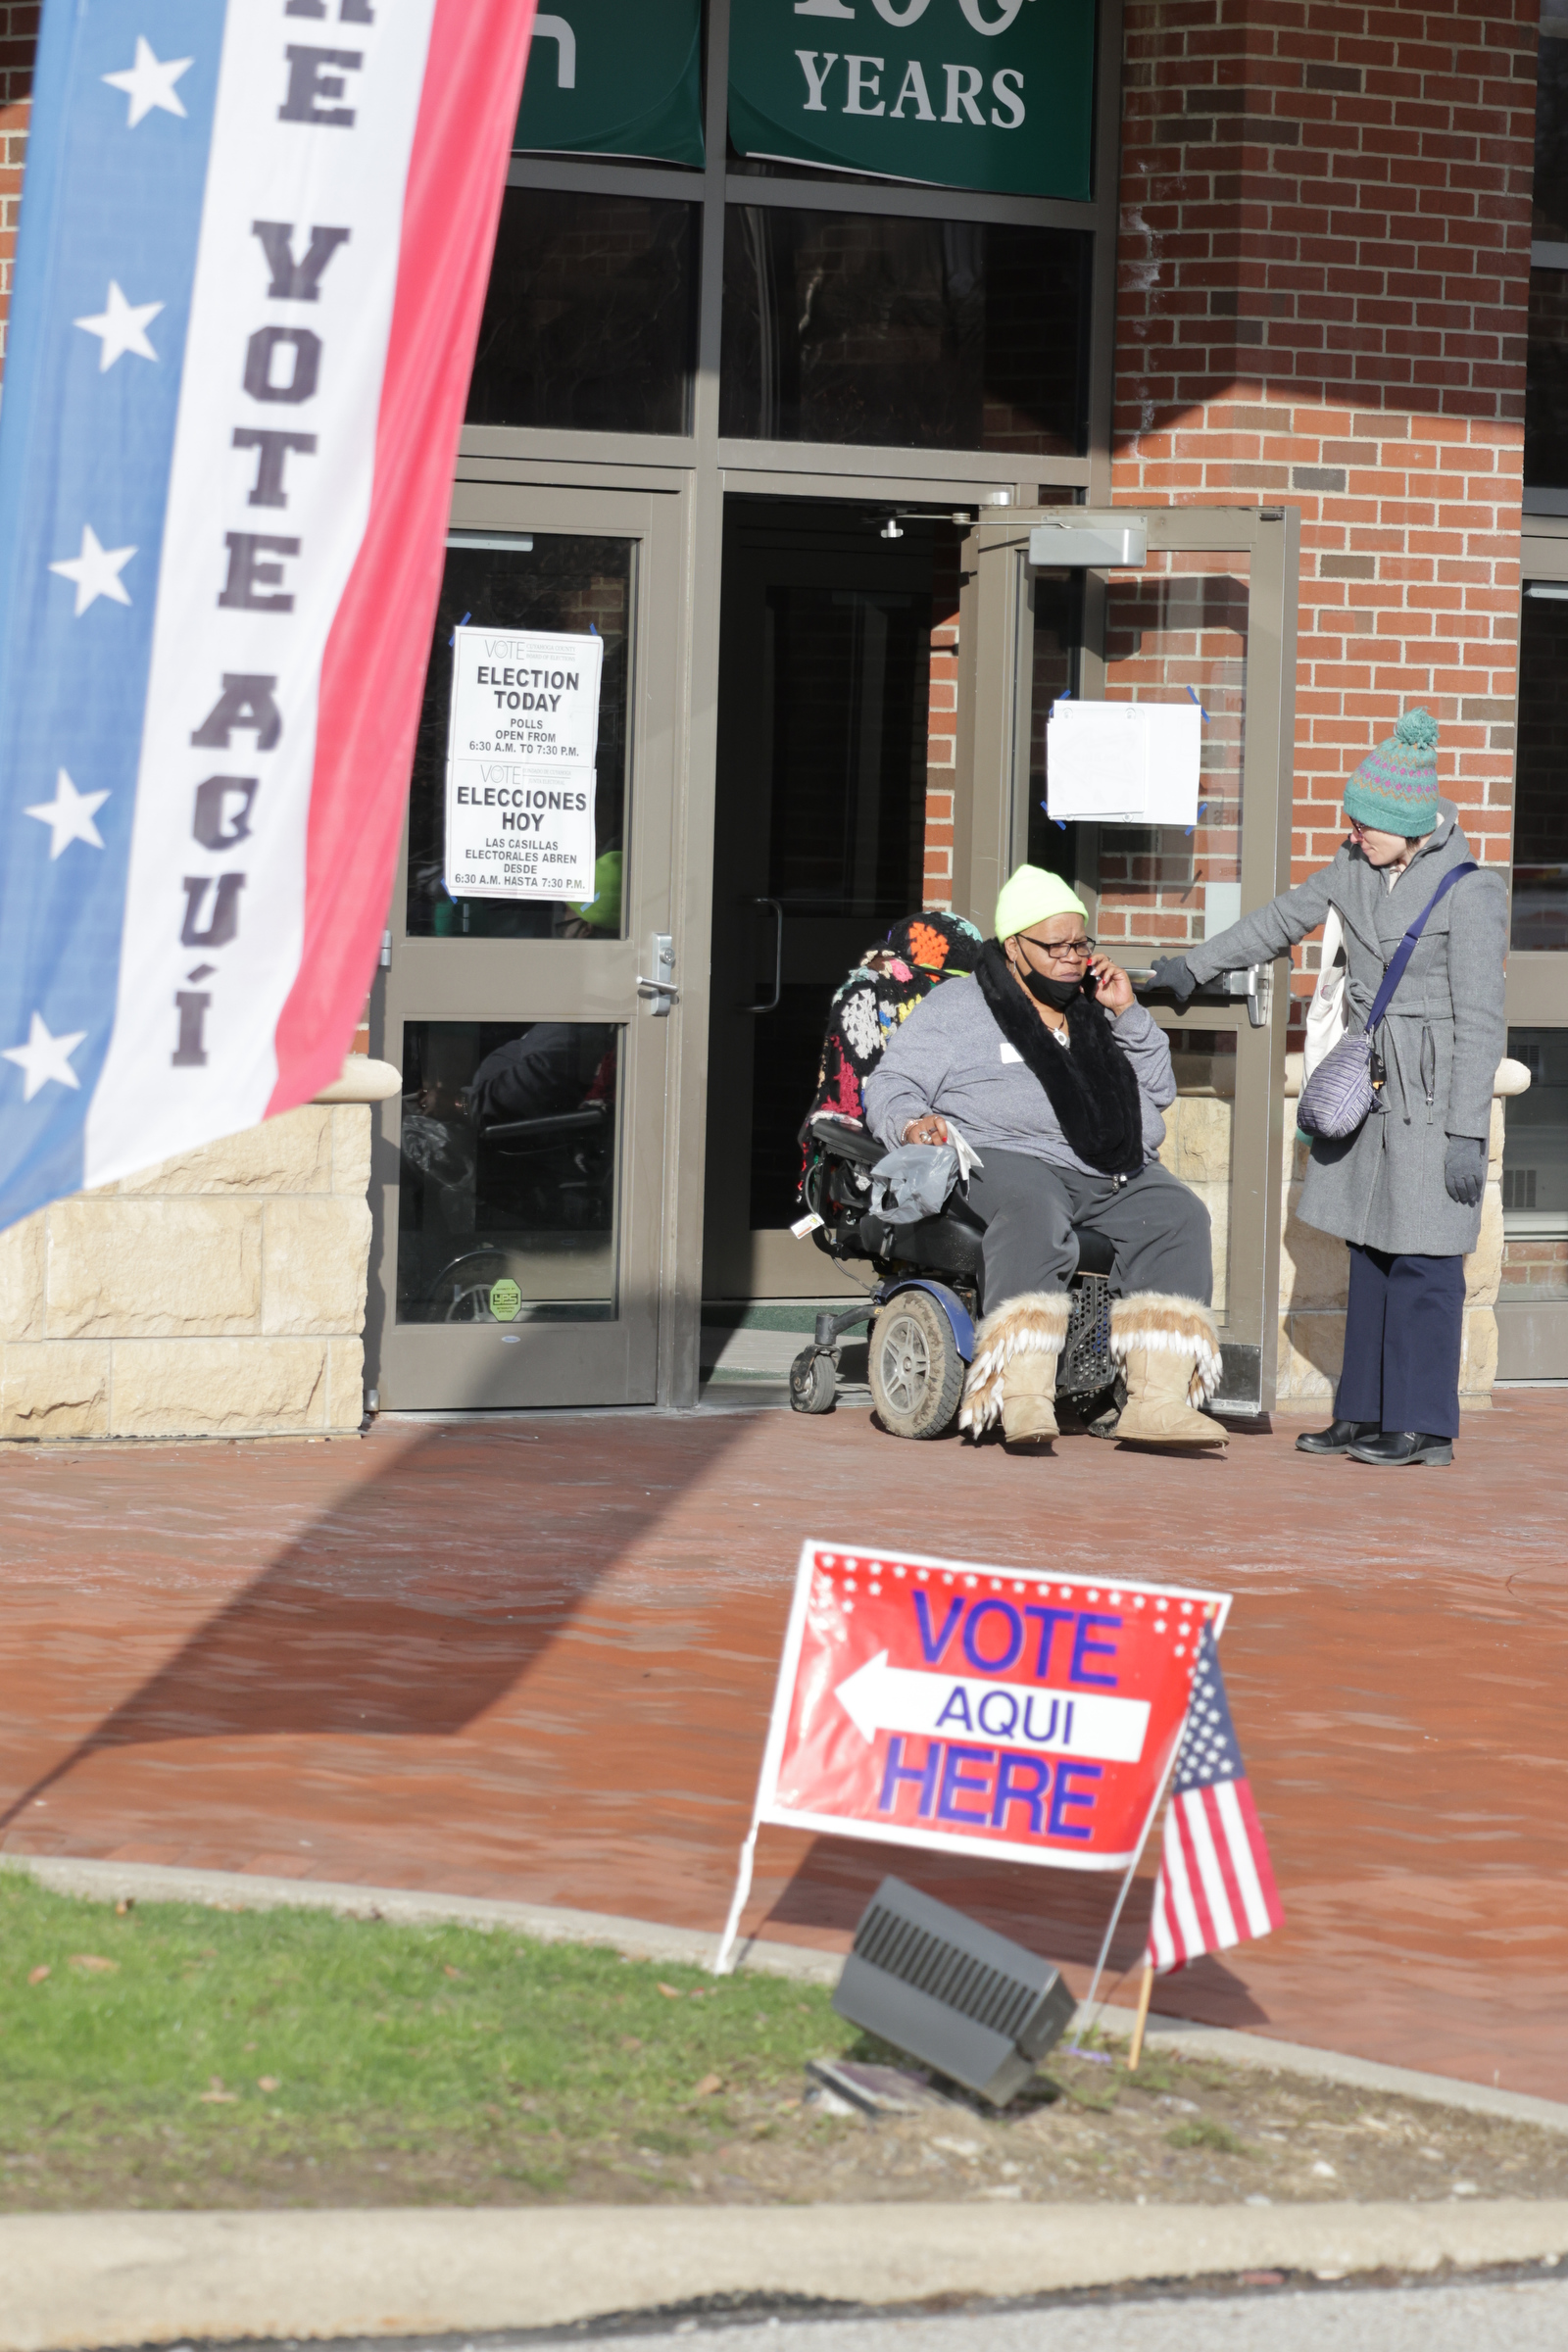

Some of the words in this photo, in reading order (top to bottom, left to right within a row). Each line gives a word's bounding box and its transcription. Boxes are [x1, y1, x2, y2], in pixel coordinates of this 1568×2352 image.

[794, 49, 1026, 129] YEARS
[217, 219, 352, 612] VOTE
[485, 639, 525, 660] VOTE
[477, 665, 579, 691] ELECTION
[494, 690, 562, 712] TODAY
[510, 718, 543, 729] POLLS
[495, 730, 524, 741] OPEN
[527, 731, 556, 743] FROM
[469, 741, 491, 752] 6:30
[494, 742, 516, 753] A.M.
[520, 744, 533, 754] TO
[537, 745, 558, 755] 7:30
[561, 747, 579, 757] P.M.
[480, 764, 521, 784] VOTE
[457, 786, 587, 811] ELECCIONES
[502, 811, 545, 832] HOY
[485, 838, 506, 848] LAS
[509, 839, 559, 851] CASILLAS
[466, 849, 539, 862] ELECTORALES
[542, 853, 577, 864] ABREN
[504, 863, 538, 874] DESDE
[455, 873, 476, 884] 6:30
[479, 874, 501, 885] A.M.
[504, 876, 538, 887] HASTA
[542, 878, 564, 888] 7:30
[565, 879, 586, 889] P.M.
[911, 1589, 1123, 1689] VOTE
[934, 1686, 1075, 1745] AQUI
[877, 1736, 1103, 1841] HERE
